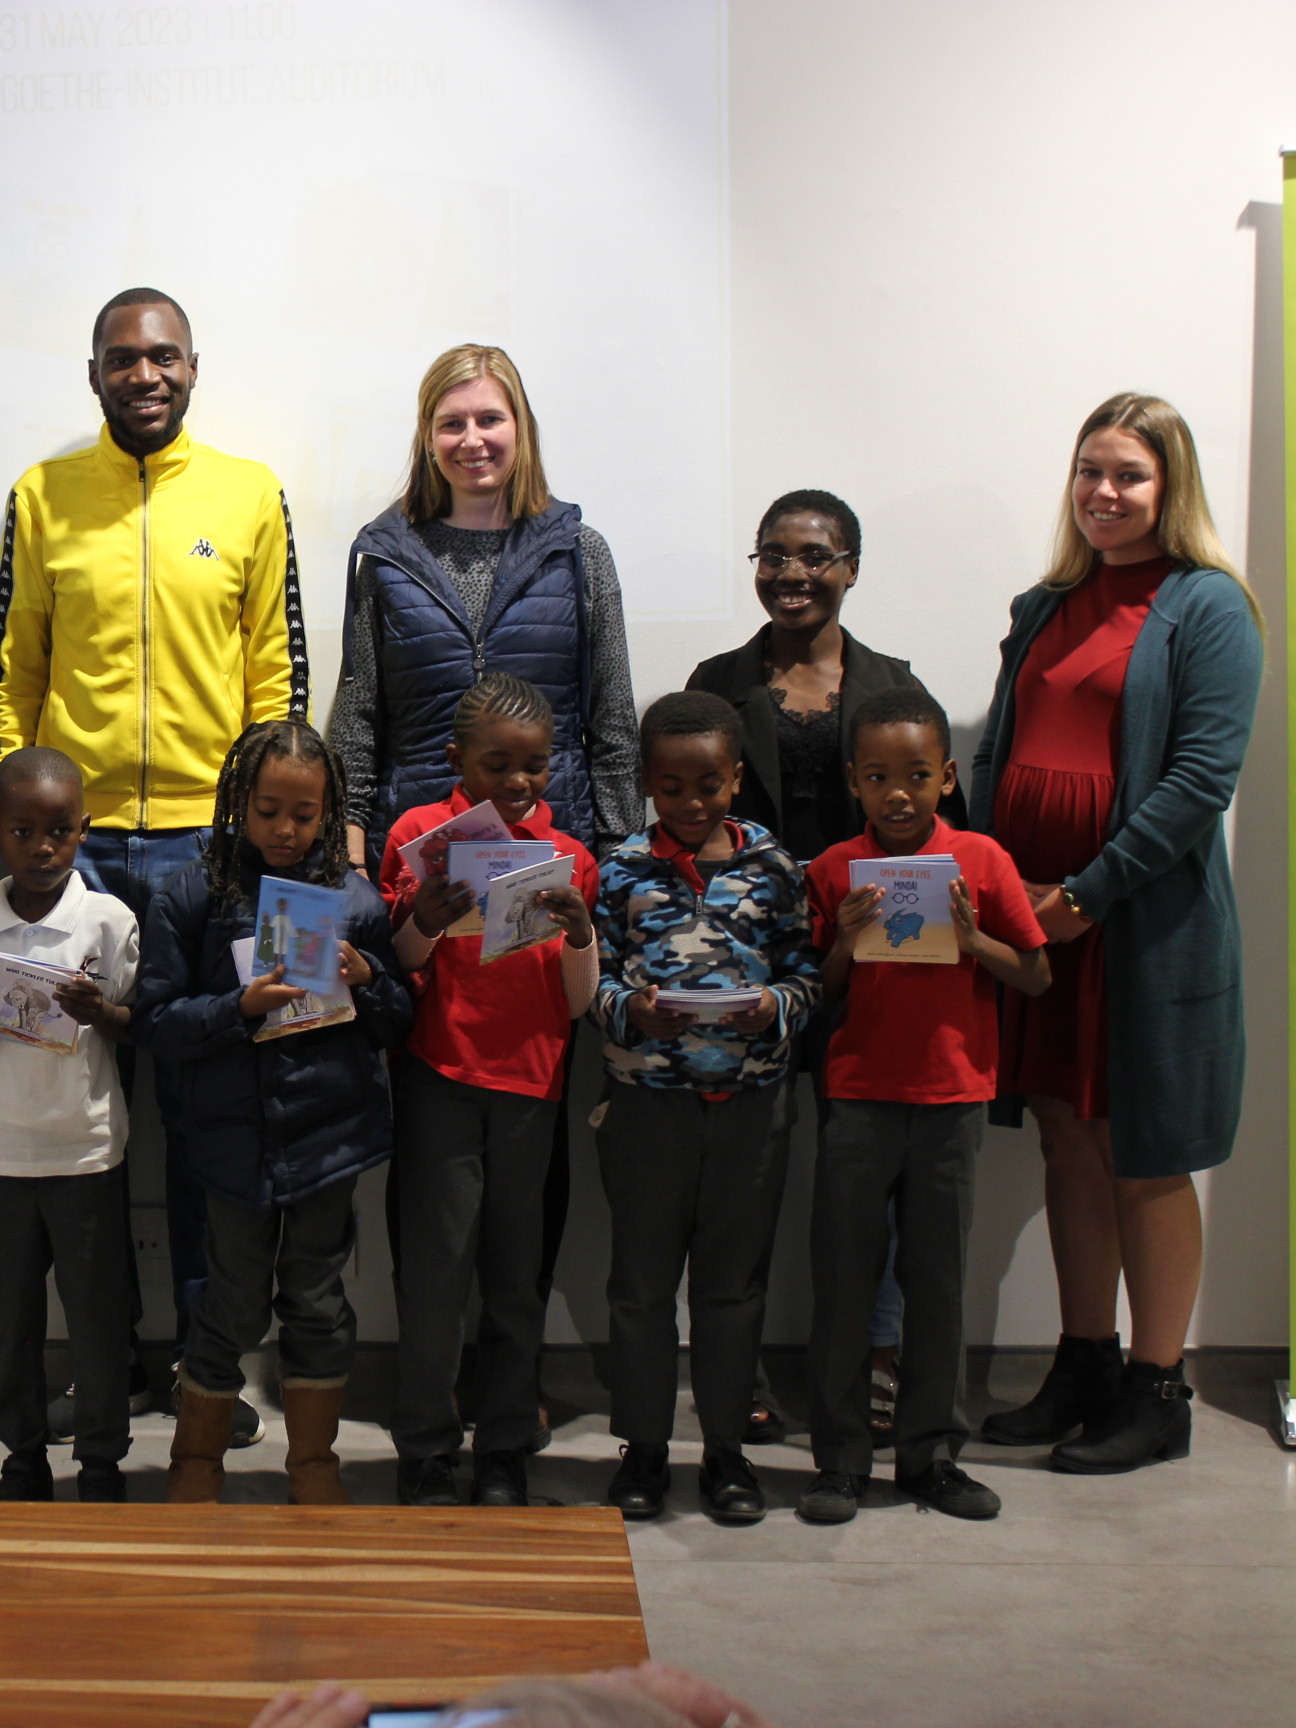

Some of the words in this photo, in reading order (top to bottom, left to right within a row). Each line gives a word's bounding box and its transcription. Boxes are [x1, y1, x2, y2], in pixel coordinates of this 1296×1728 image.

[39, 10, 105, 49] MAY
[114, 5, 192, 48] 2023
[268, 58, 447, 102] AUDITORIUM
